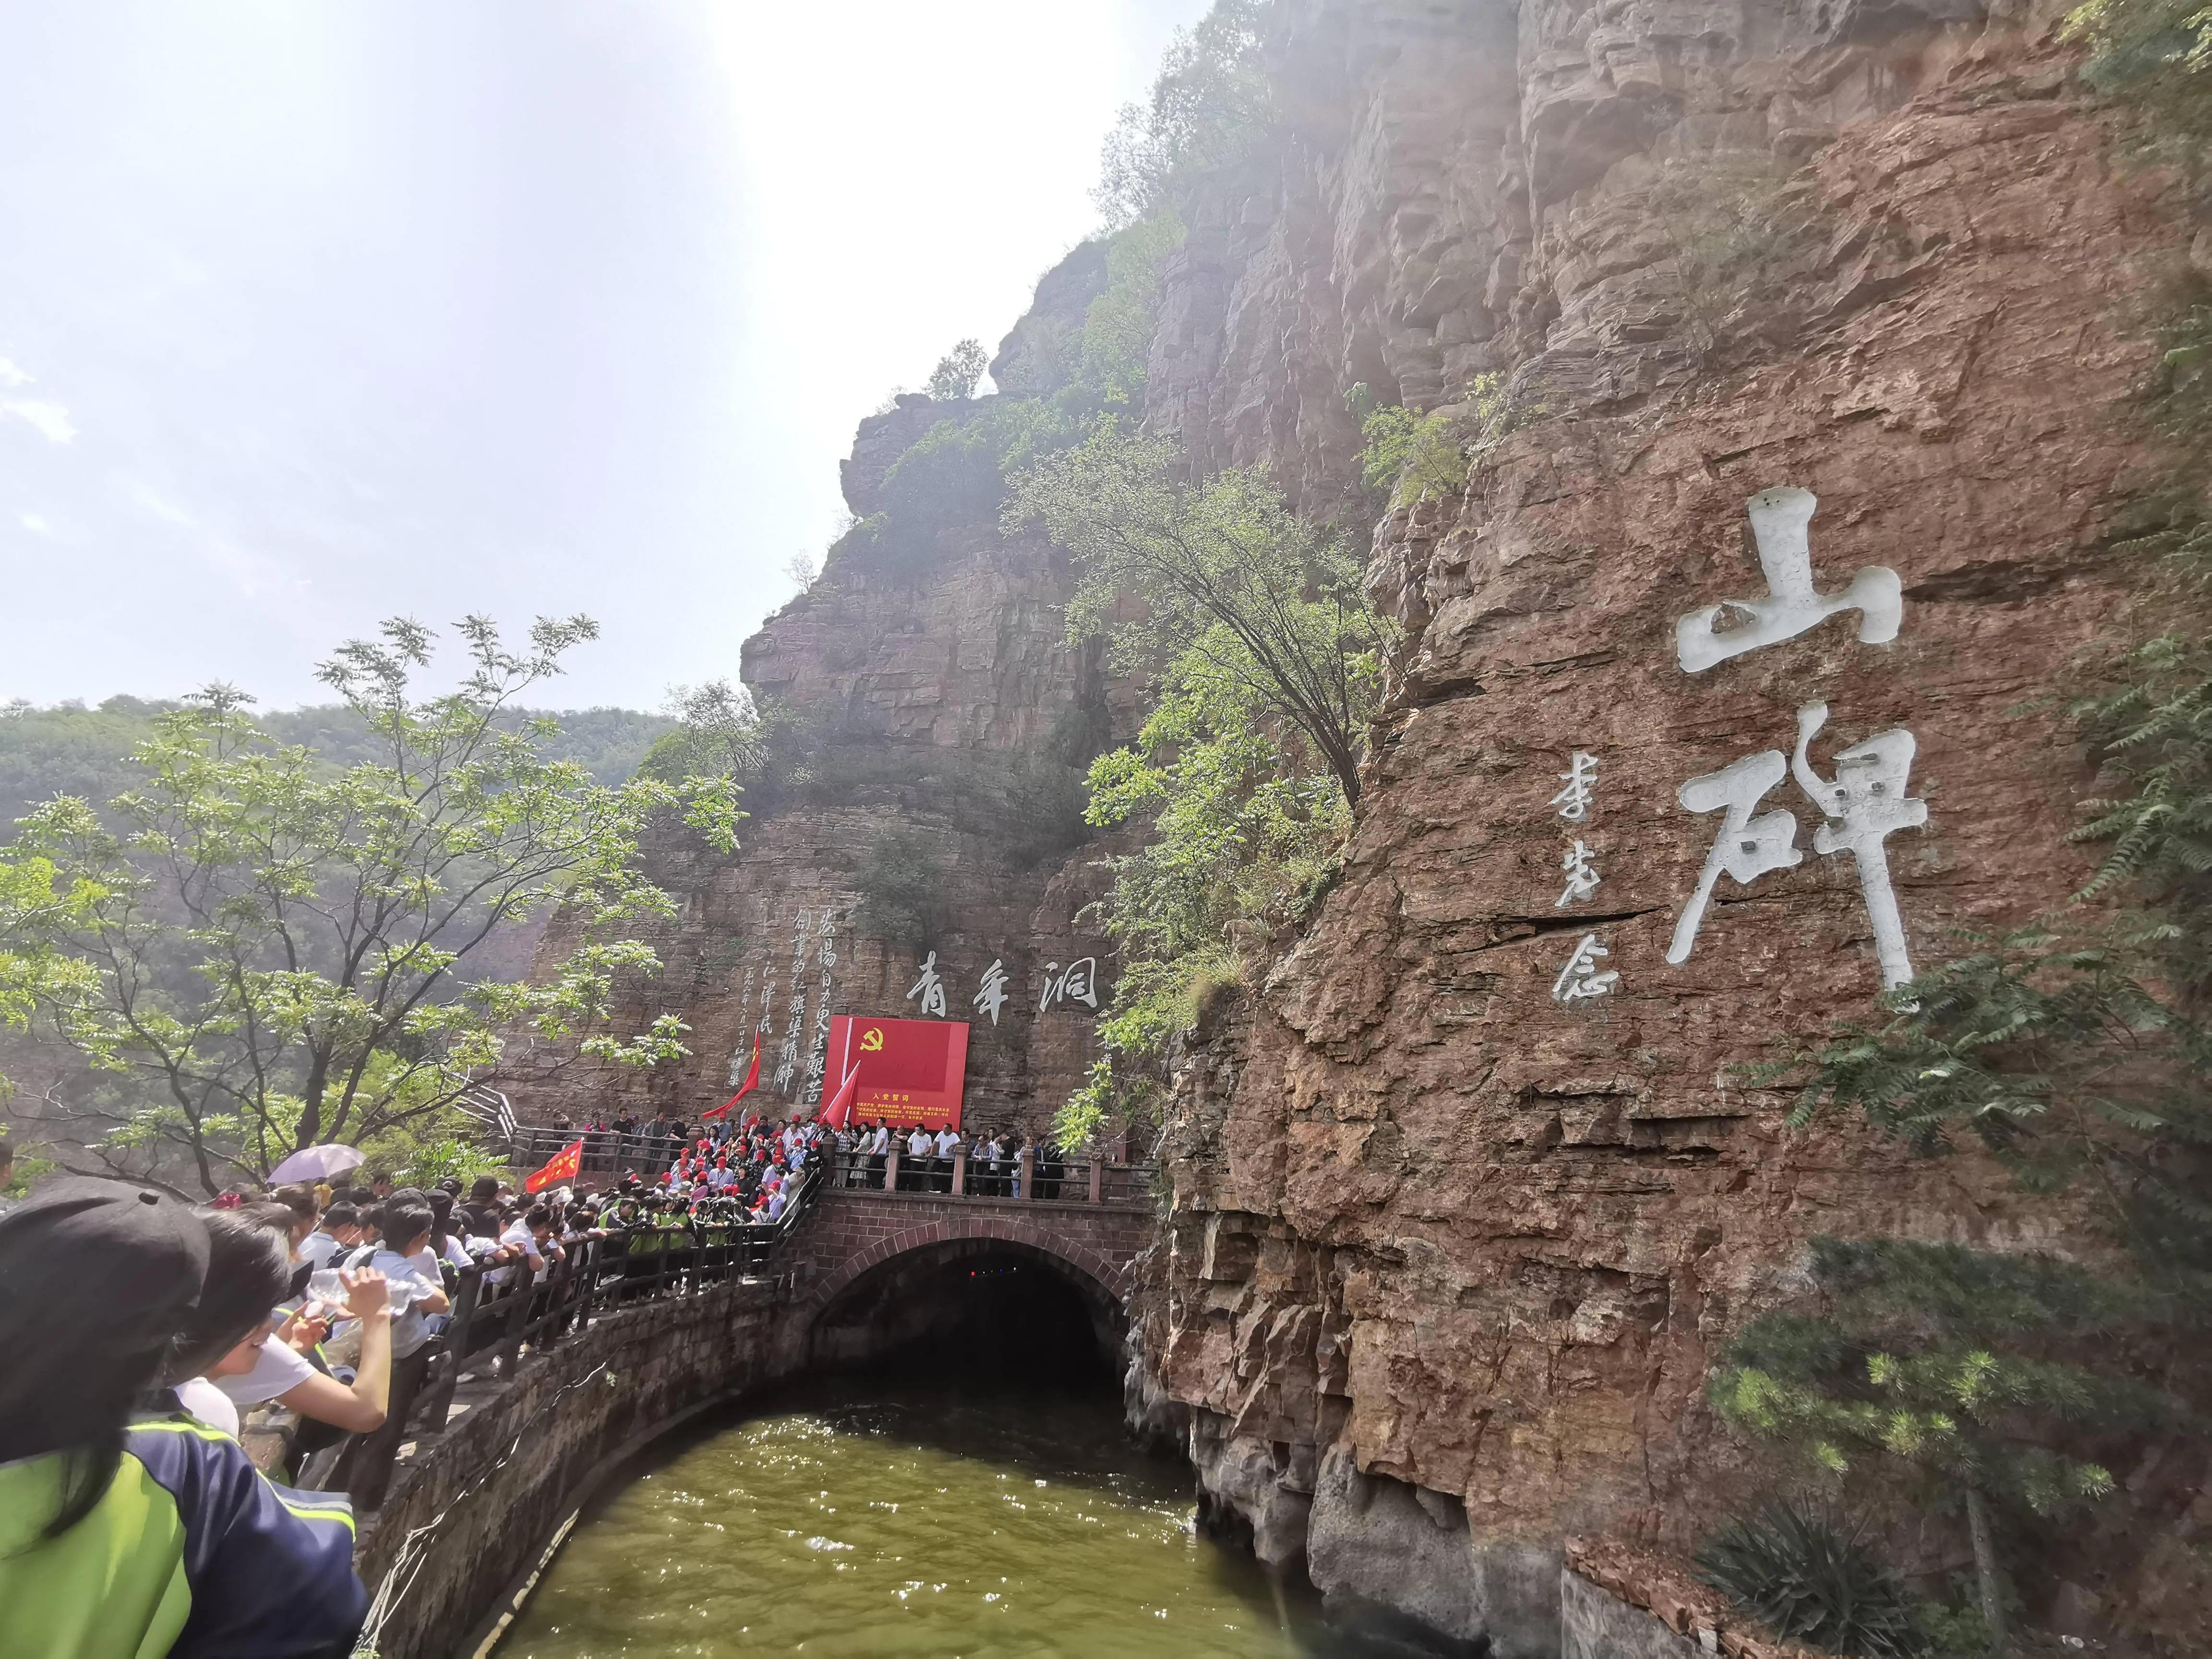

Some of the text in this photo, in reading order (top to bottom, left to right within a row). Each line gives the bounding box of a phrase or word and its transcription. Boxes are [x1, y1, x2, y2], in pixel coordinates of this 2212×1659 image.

[1551, 750, 1619, 1002] 李先念
[906, 950, 1098, 1026] 青年洞
